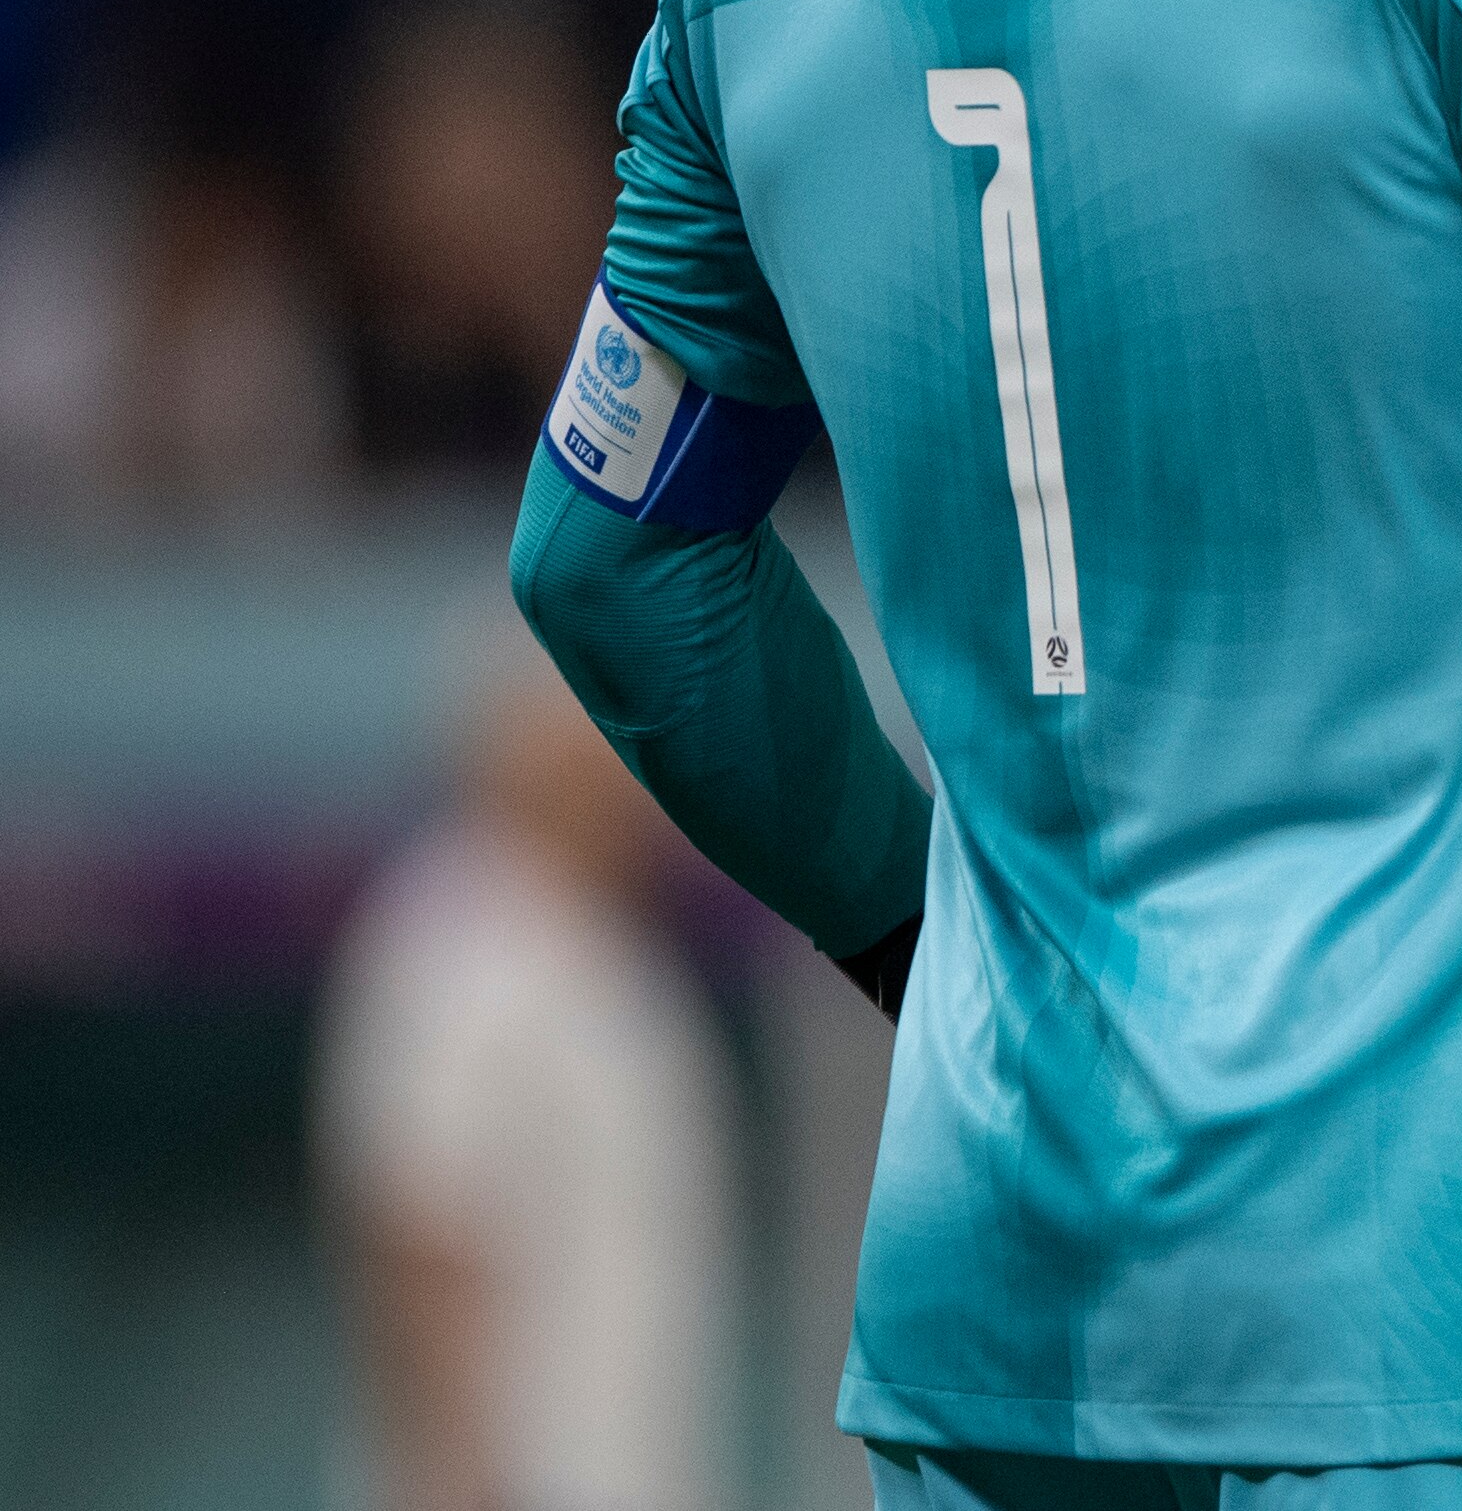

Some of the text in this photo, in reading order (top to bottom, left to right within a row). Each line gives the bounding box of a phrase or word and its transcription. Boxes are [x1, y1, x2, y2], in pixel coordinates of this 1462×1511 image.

[576, 374, 636, 439] Organization
[582, 359, 641, 424] World Health
[925, 68, 1086, 695] 1
[568, 431, 595, 467] FIFA
